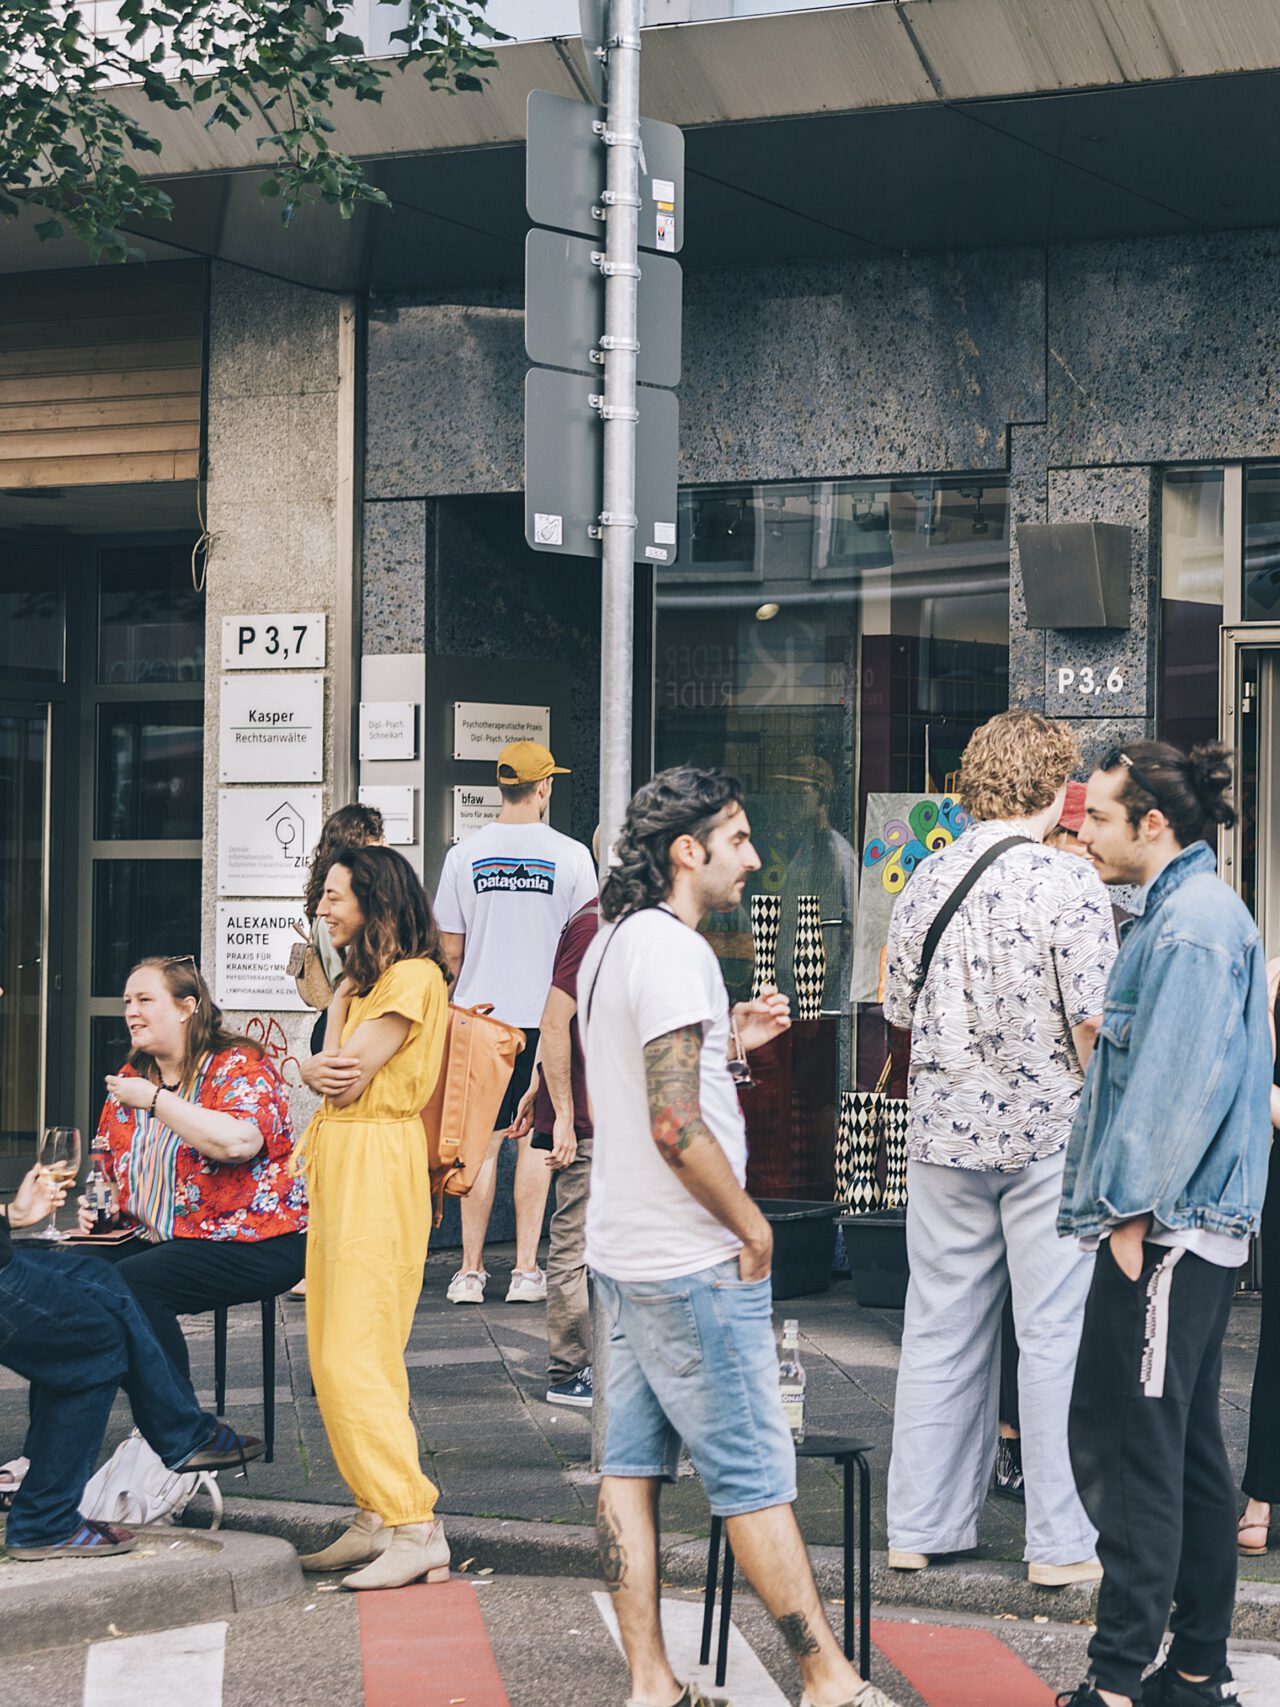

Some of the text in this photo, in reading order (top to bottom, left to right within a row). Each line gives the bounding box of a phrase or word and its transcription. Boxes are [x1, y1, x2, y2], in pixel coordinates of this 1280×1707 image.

[239, 625, 308, 660] P 3,7
[248, 709, 295, 726] Kasper
[462, 720, 543, 732] Psychotherapeutische Praxis
[235, 732, 307, 744] Rechtsanwälte
[461, 793, 484, 805] bfaw
[477, 875, 549, 892] patagonia
[227, 916, 305, 929] ALEXANDRA
[226, 933, 270, 945] KORTE
[226, 952, 272, 960] PRAXIS FÜR
[226, 963, 286, 972] KRANKENGYMN
